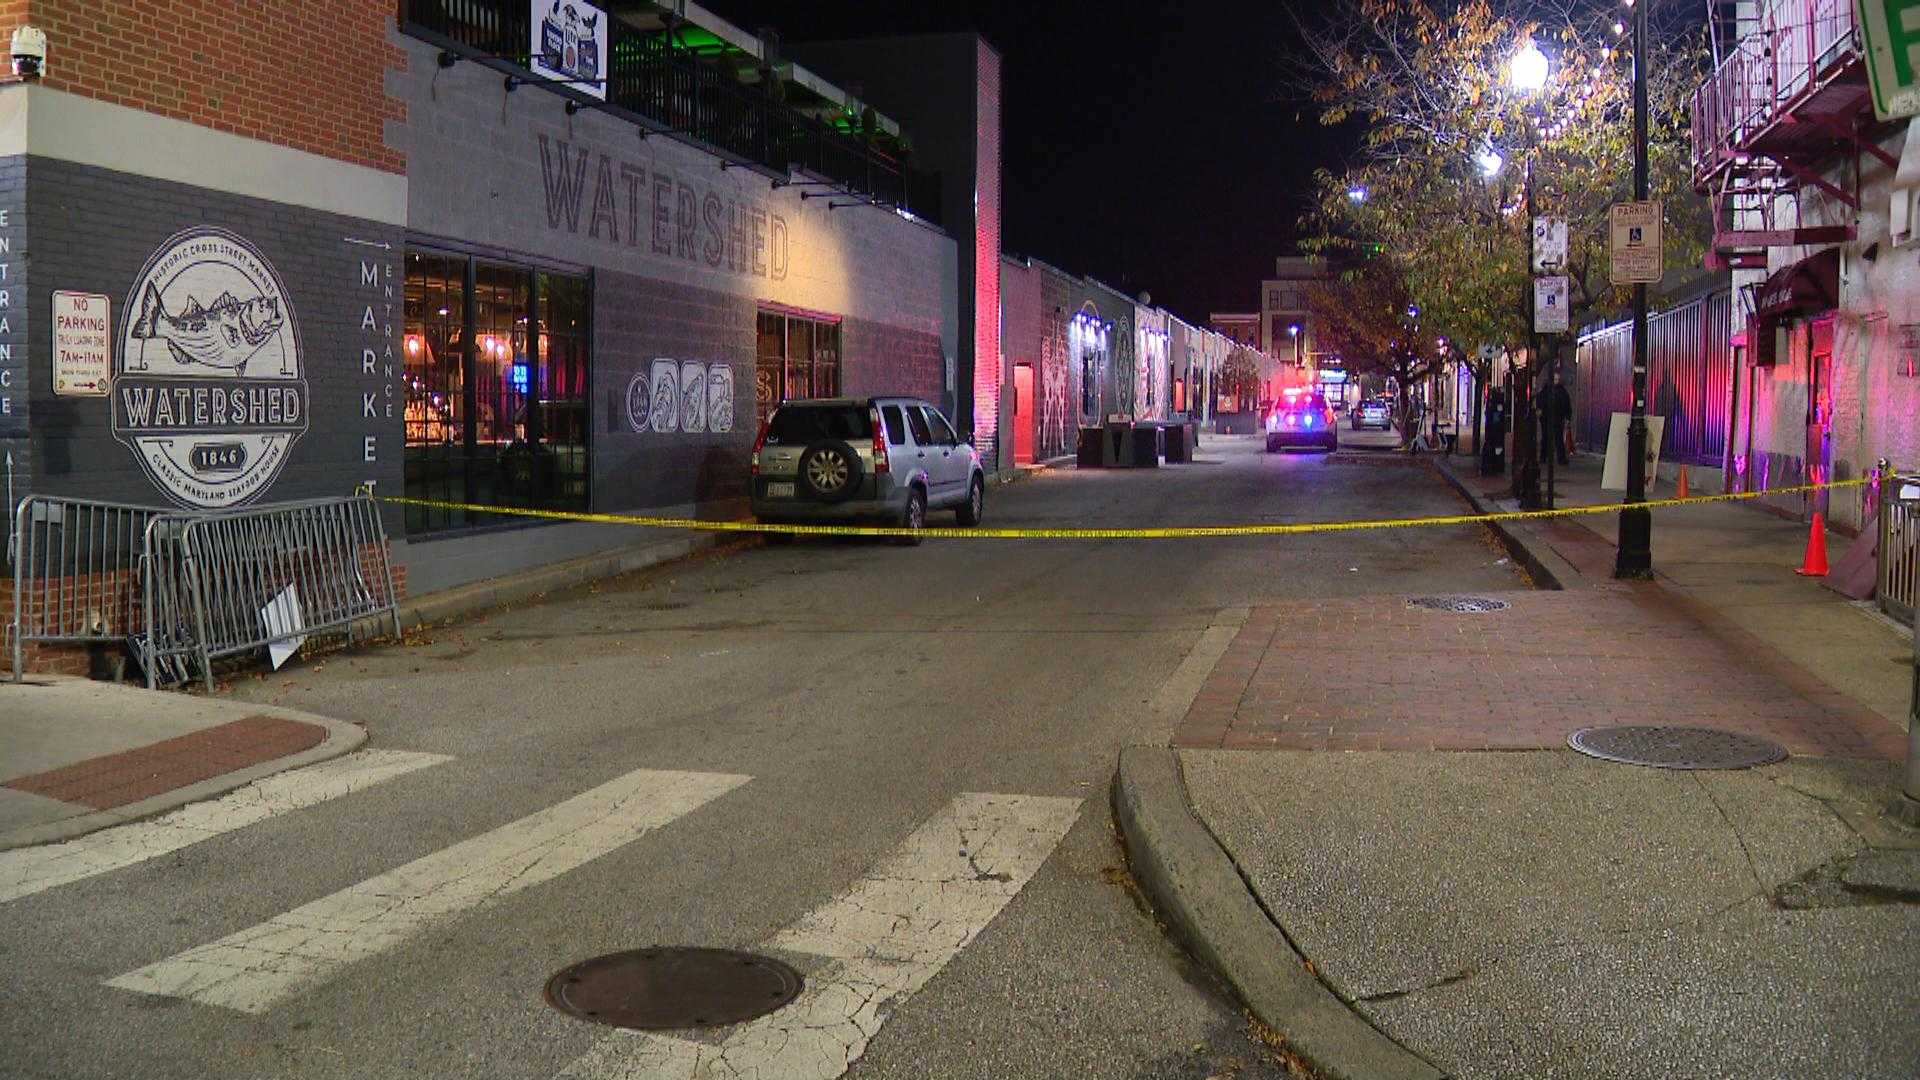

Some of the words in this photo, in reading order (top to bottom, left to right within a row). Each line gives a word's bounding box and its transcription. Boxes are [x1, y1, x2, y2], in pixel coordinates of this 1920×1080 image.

[537, 133, 788, 282] WATERSHED
[154, 247, 188, 282] HISTORIC
[190, 243, 217, 255] CROSS
[220, 245, 247, 263] STREET
[248, 260, 275, 295] MARKET
[0, 209, 11, 414] ENTRANCE
[57, 316, 104, 331] PARKING
[73, 298, 88, 311] NO
[384, 264, 393, 417] ENTRANCE
[361, 261, 378, 497] MARKET
[122, 387, 300, 427] WATERSHED
[152, 454, 181, 487] CLASSIC
[183, 485, 225, 500] MARYLAND
[229, 472, 260, 497] SEAFOOD
[261, 446, 279, 475] HOUSE
[201, 450, 237, 465] 1846
